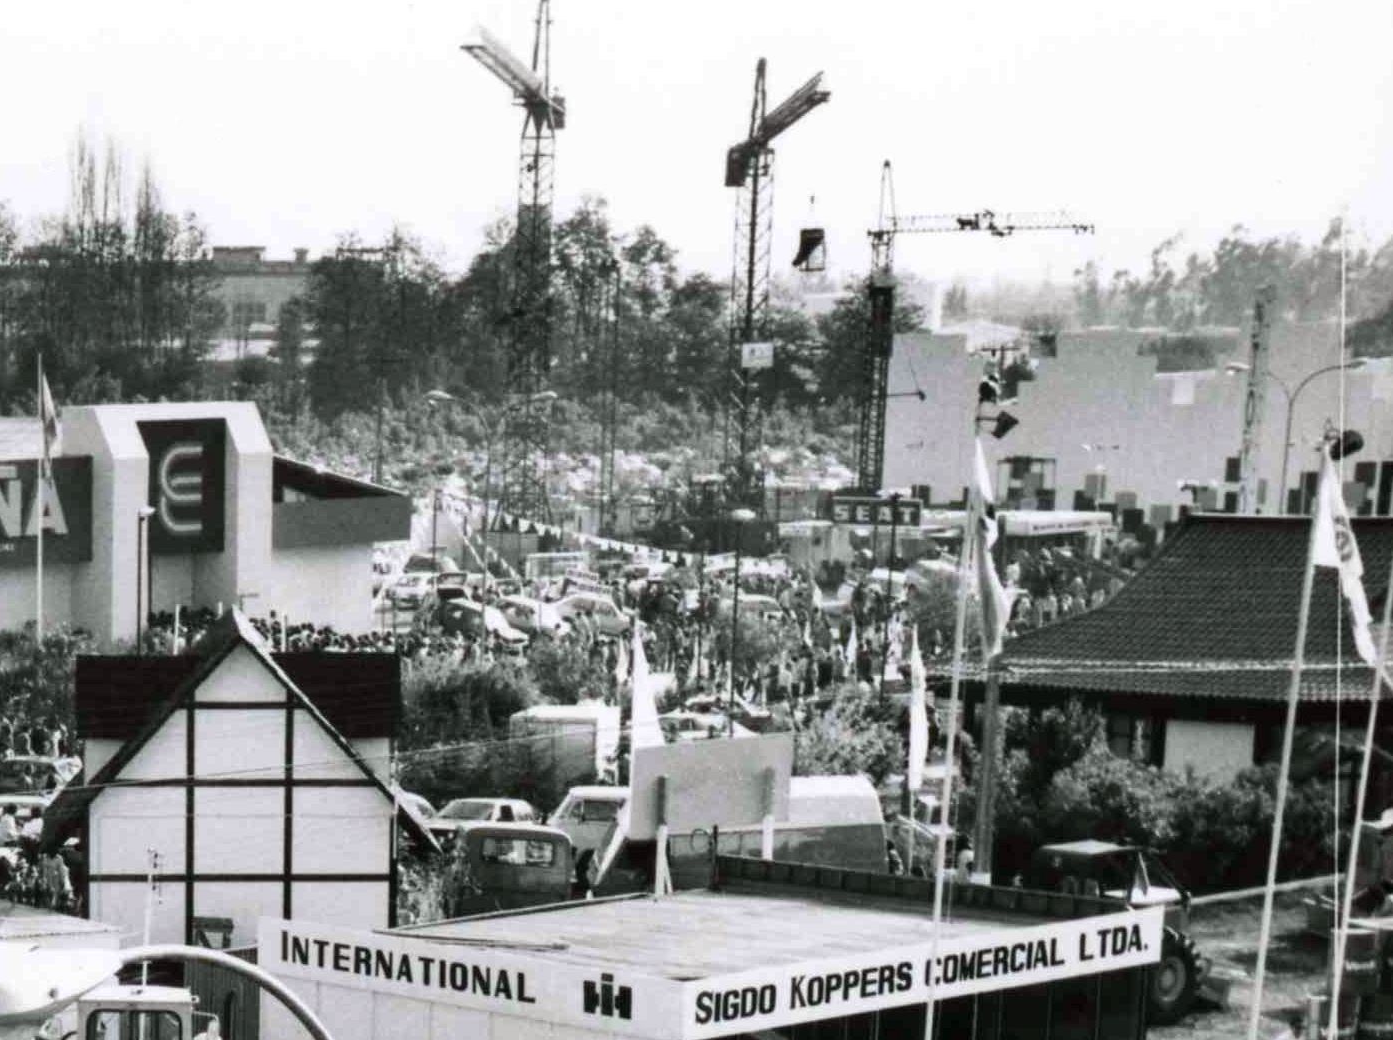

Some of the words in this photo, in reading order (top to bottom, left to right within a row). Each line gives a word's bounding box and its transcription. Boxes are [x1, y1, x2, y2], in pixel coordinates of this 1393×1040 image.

[833, 505, 915, 523] SEAT
[281, 930, 536, 1004] INTERNATIONAL
[694, 984, 777, 1026] SIGDO
[790, 962, 913, 1010] KOPPERS
[925, 938, 1065, 987] COMERCIAL
[1079, 923, 1149, 962] LTDA.
